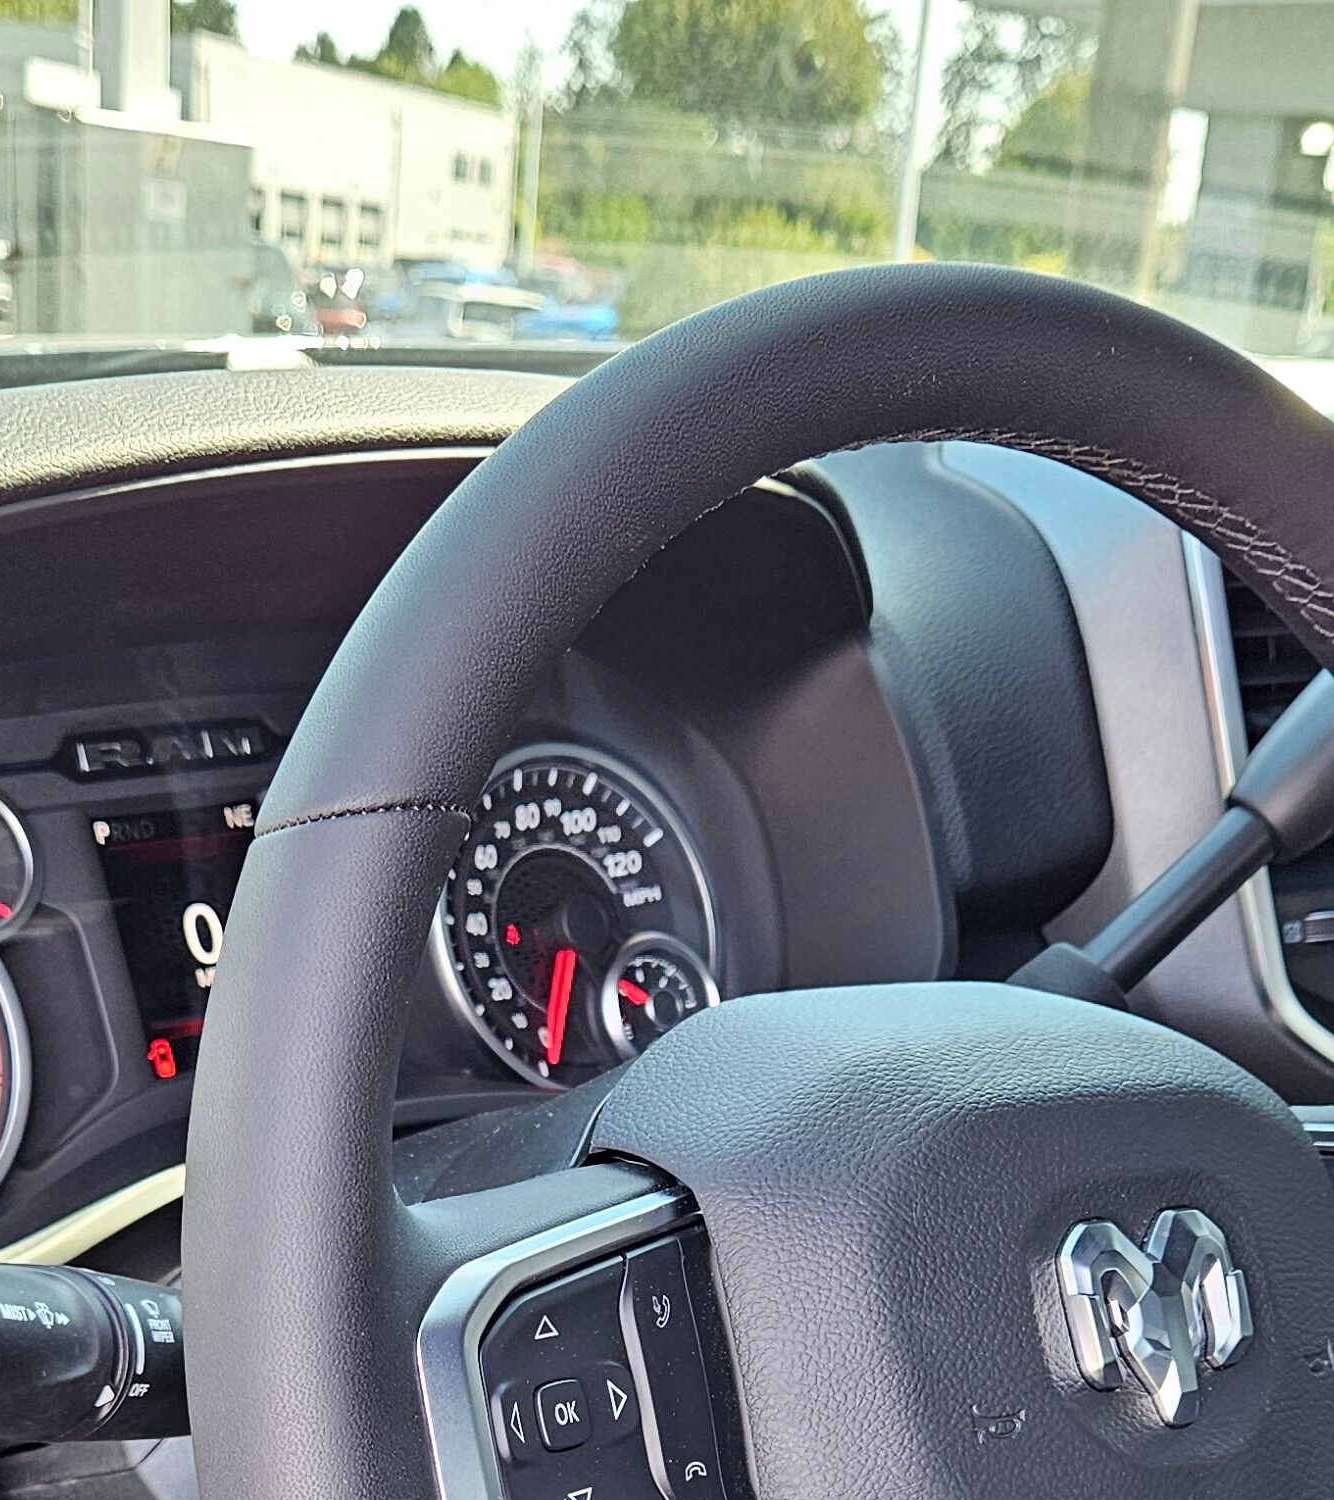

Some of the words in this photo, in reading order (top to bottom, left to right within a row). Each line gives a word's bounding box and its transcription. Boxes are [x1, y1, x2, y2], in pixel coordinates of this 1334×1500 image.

[76, 729, 252, 773] RAM
[515, 802, 541, 831] 80
[560, 807, 597, 836] 100
[603, 850, 643, 879] 120
[147, 1318, 172, 1332] FRONT
[151, 1330, 176, 1344] WIPER
[128, 1383, 151, 1398] OFF
[555, 1400, 580, 1425] OK
